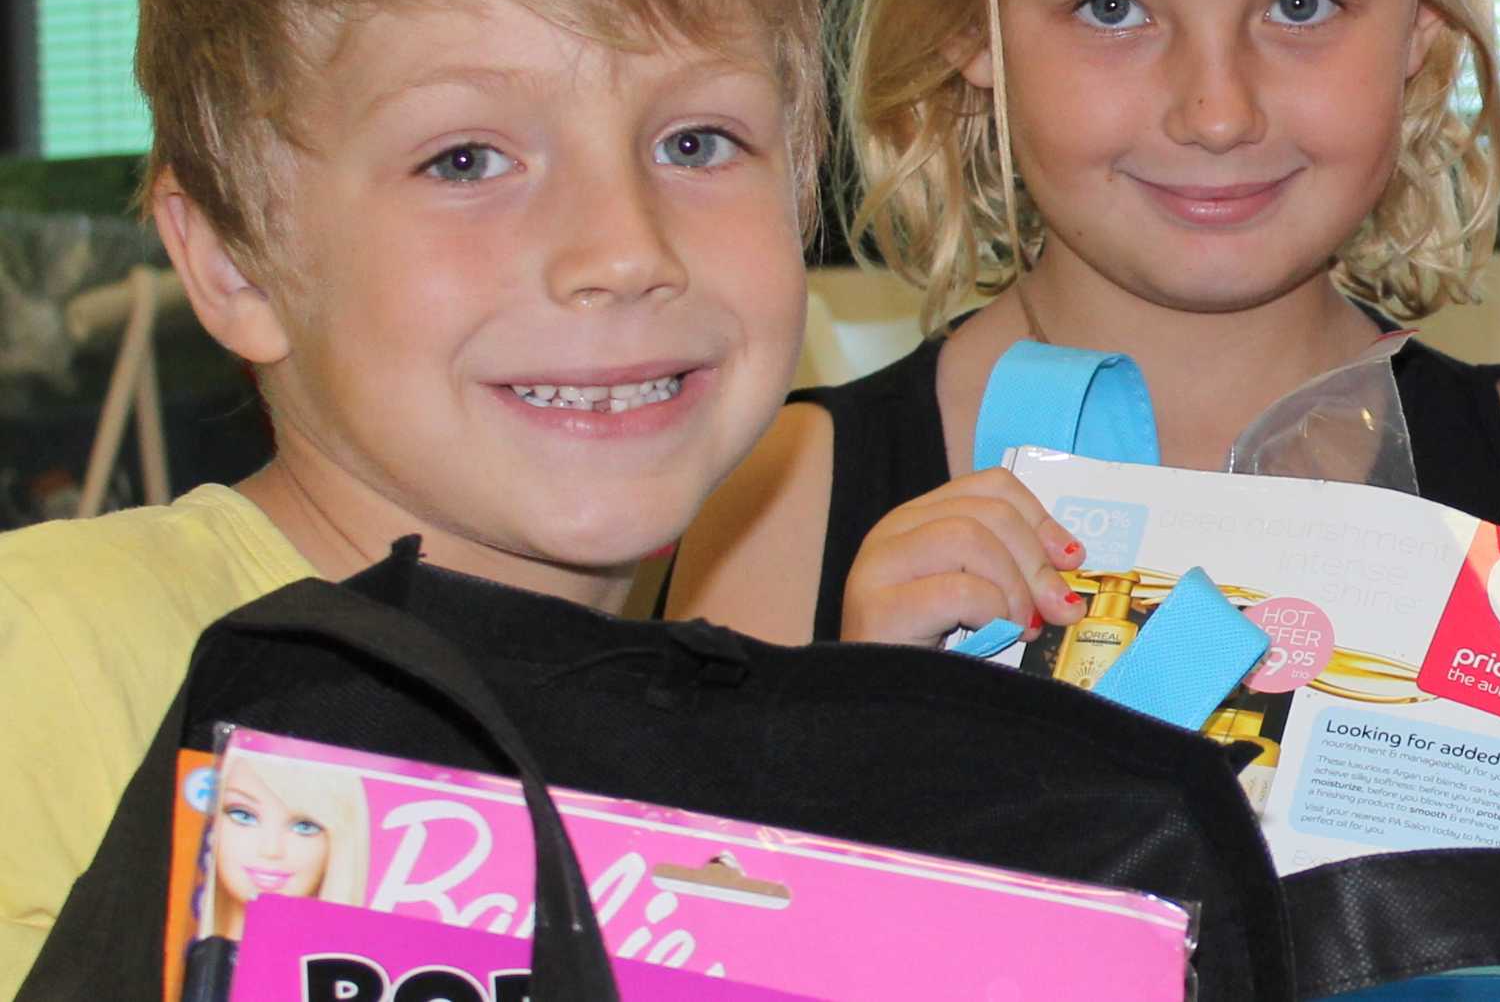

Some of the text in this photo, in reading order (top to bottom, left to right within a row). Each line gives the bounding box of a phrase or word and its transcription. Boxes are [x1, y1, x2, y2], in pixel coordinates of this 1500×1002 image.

[1262, 607, 1315, 627] HOT
[1264, 625, 1321, 647] FFER
[1264, 647, 1317, 676] 9.95
[1447, 668, 1476, 687] the
[1326, 719, 1402, 748] Looking
[1407, 733, 1436, 751] for
[1320, 738, 1388, 757] nourishment
[1399, 752, 1471, 775] manageability
[1472, 765, 1488, 777] for
[1392, 768, 1421, 781] Argan
[1367, 786, 1399, 798] before
[1399, 793, 1418, 803] you
[1356, 797, 1396, 811] product
[1408, 806, 1448, 820] smooth
[369, 799, 726, 978] Babie
